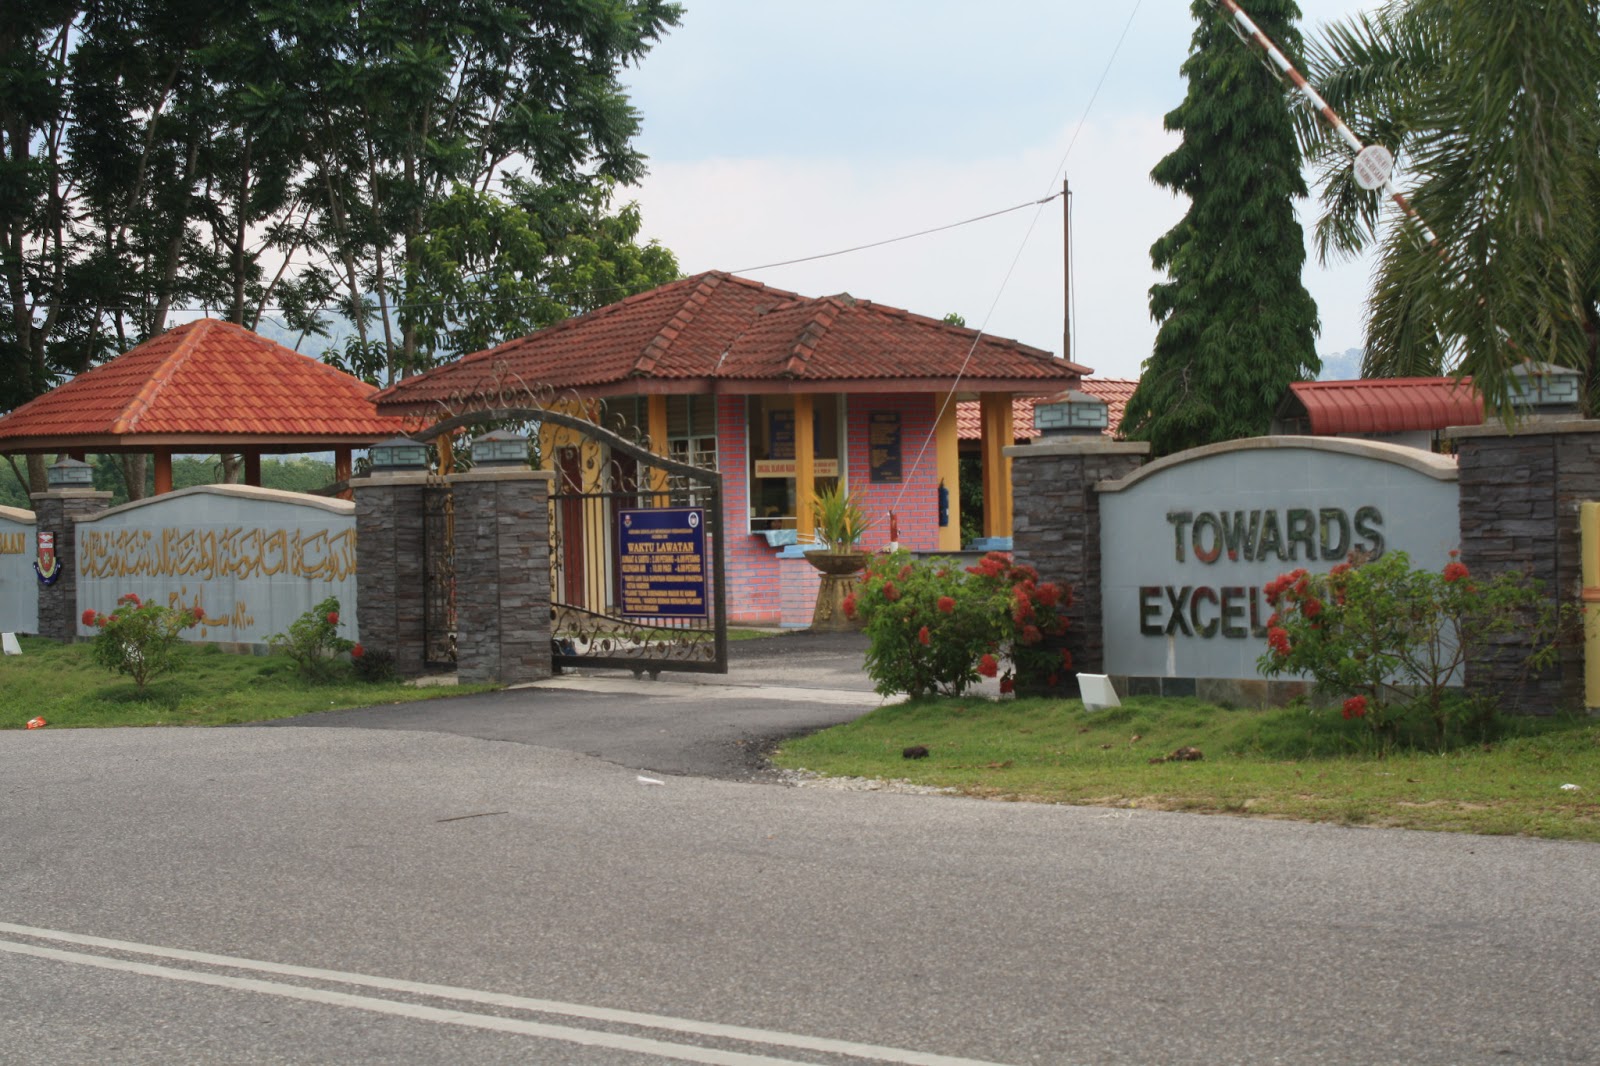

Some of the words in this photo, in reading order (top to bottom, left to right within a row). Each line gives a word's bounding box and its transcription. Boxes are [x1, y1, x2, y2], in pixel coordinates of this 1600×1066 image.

[0, 532, 26, 554] AAN
[1166, 505, 1386, 563] TOWARDS
[627, 542, 654, 552] WAKTU
[656, 542, 694, 552] LAWATAN
